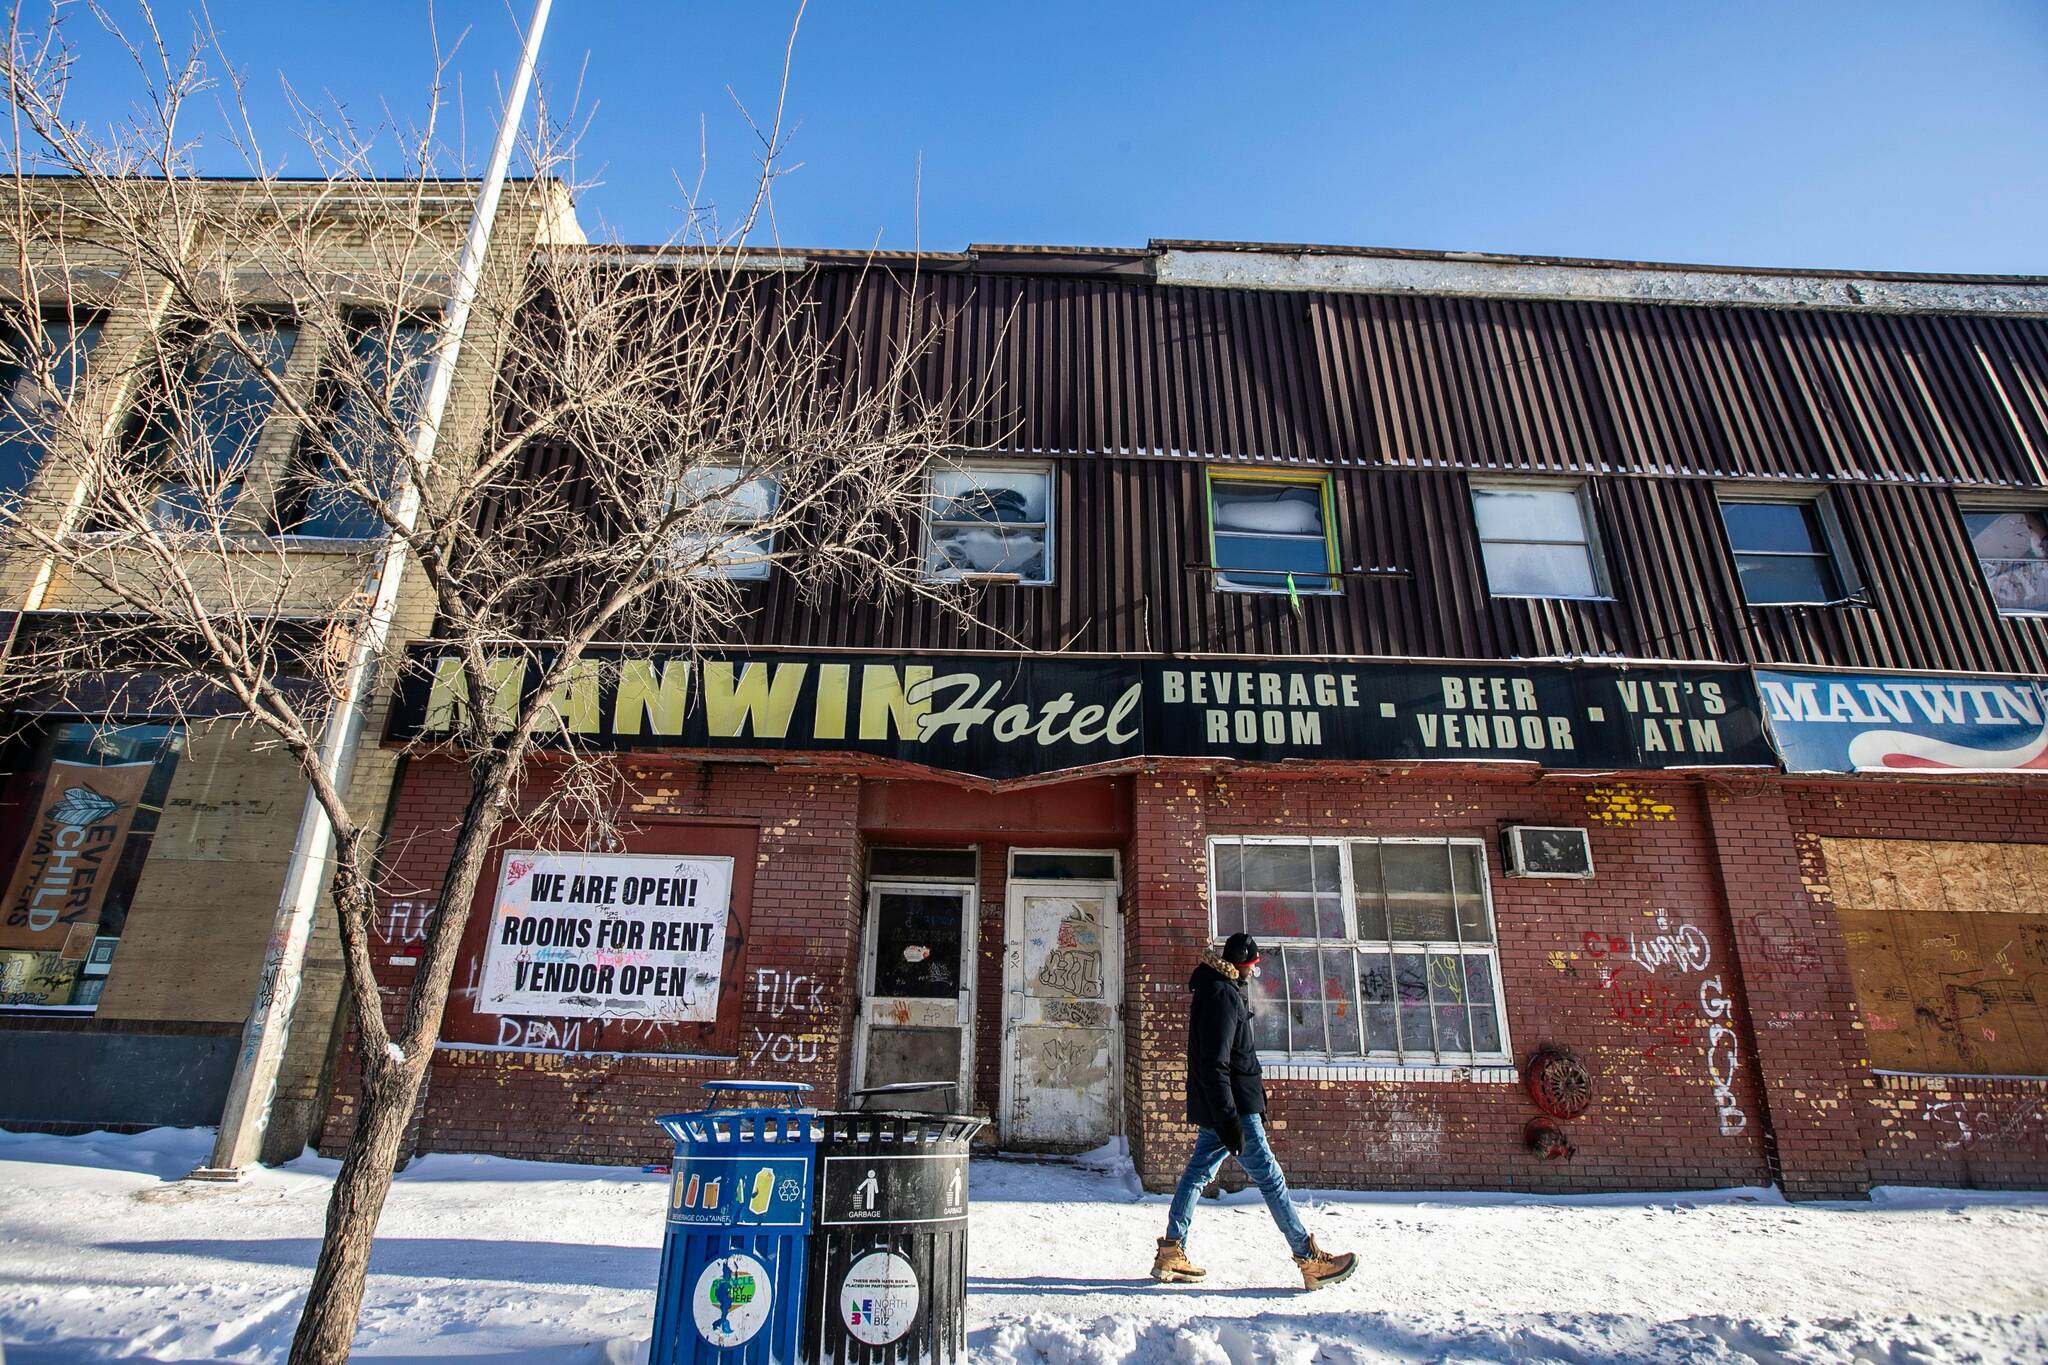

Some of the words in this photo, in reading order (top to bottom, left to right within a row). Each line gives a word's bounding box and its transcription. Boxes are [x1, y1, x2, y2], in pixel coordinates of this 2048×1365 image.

[1162, 670, 1360, 707] BEVERAGE
[1441, 676, 1538, 711] BEER
[1615, 680, 1726, 715] VLT'S
[1760, 682, 2043, 726] MANWIN
[907, 672, 1142, 746] Hotel
[1206, 709, 1322, 745] ROOM
[1416, 713, 1576, 750] VENDOR
[1645, 718, 1723, 753] ATM
[7, 823, 58, 928] MATTERS
[28, 826, 87, 932] CHILD
[58, 824, 117, 924] EVERY
[530, 873, 566, 902] WE
[568, 875, 618, 904] ARE
[621, 876, 698, 907] OPEN!
[501, 916, 592, 948] ROOMS
[596, 919, 645, 950] FOR
[649, 921, 714, 952] RENT
[515, 961, 615, 995] VENDOR
[619, 965, 687, 997] OPEN
[756, 968, 824, 1018] FUCK
[848, 1210, 881, 1218] GARBAGE
[873, 1317, 890, 1327] BIZ
[874, 1299, 908, 1309] NORTH
[874, 1308, 894, 1317] END
